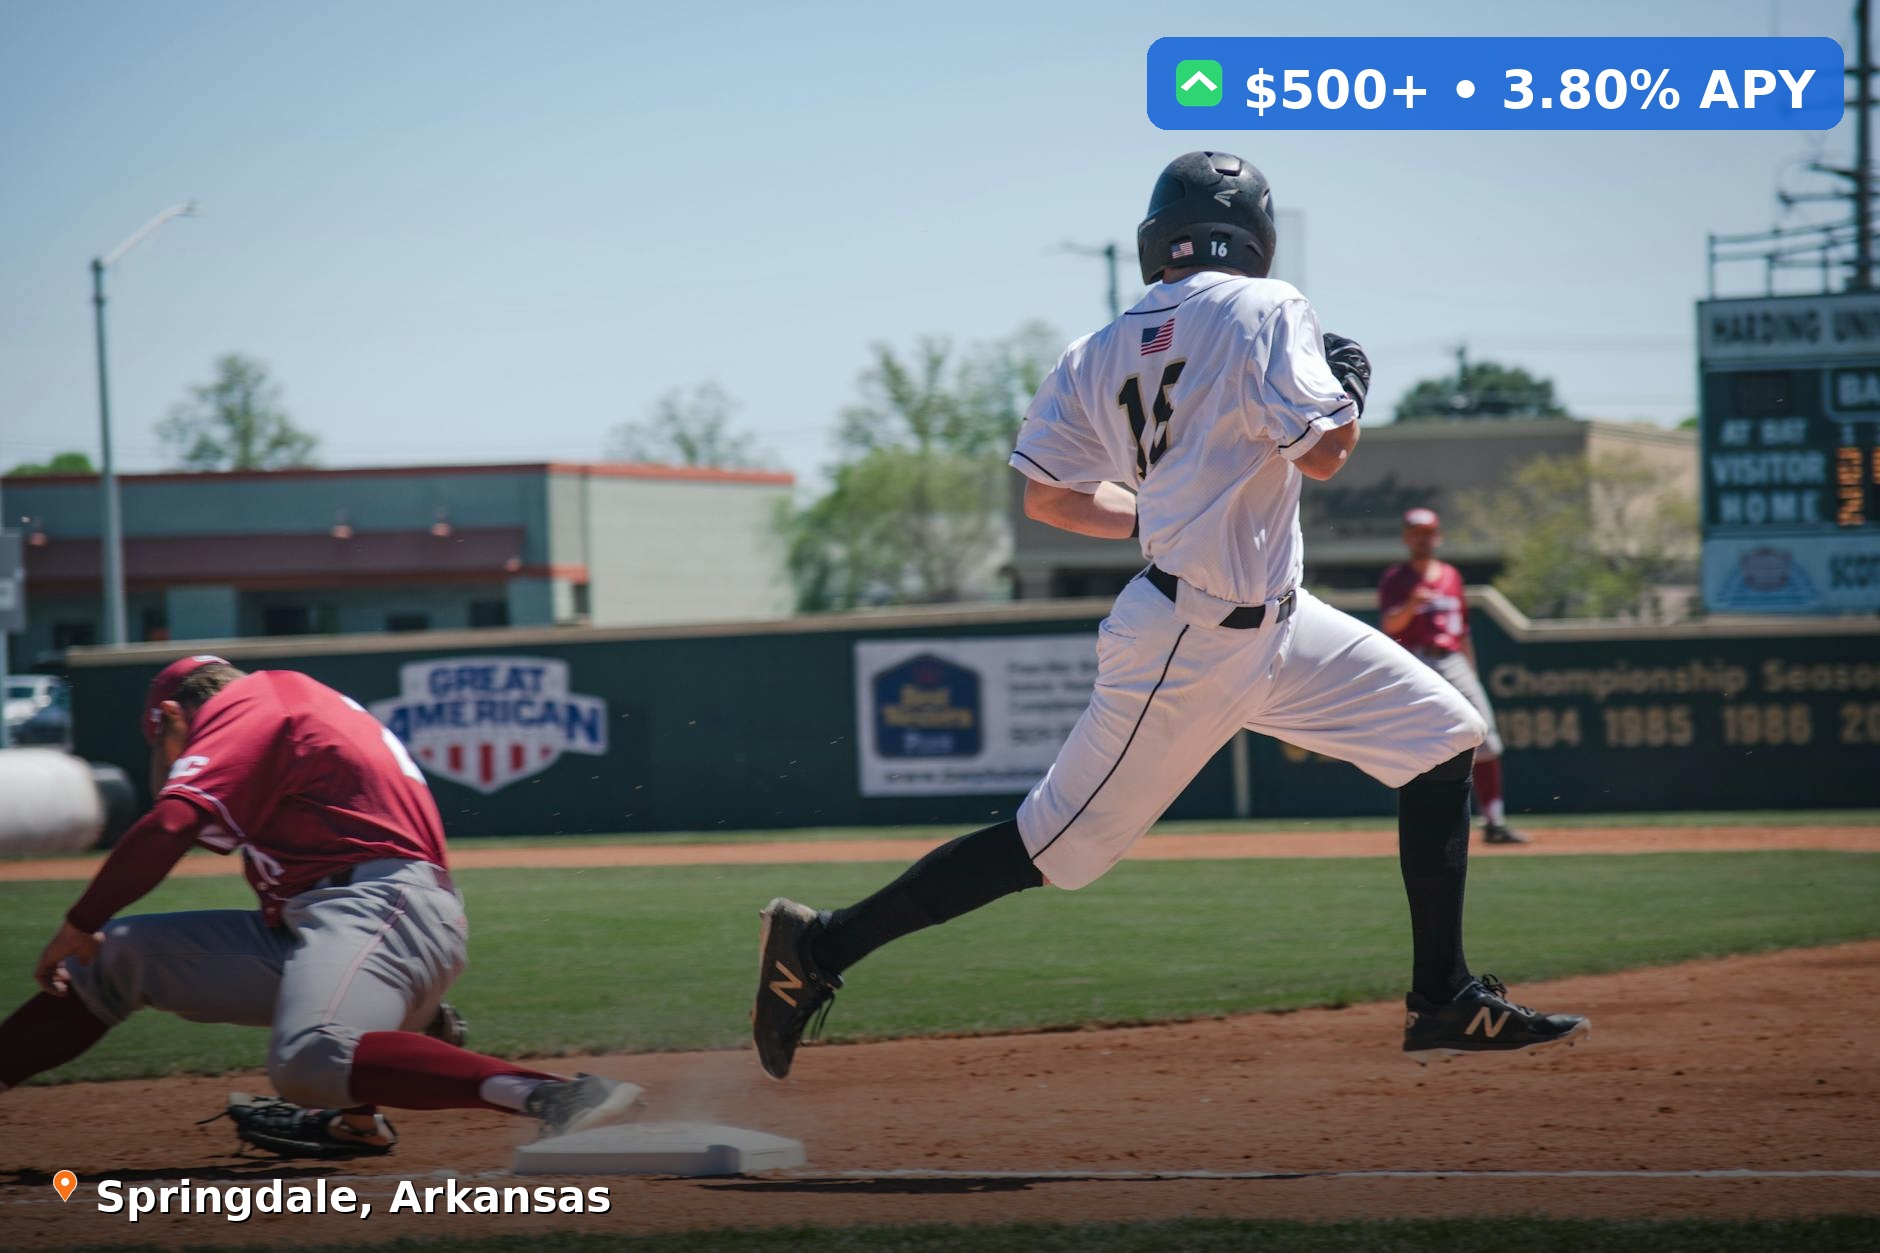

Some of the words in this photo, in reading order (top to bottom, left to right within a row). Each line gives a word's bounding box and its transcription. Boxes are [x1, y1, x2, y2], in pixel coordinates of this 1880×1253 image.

[1211, 241, 1228, 258] 16
[1710, 451, 1826, 485] VISITOR
[1719, 490, 1822, 523] HOME
[428, 665, 546, 697] GREAT
[1490, 658, 1747, 702] Championship
[1761, 657, 1880, 693] Seaso
[387, 698, 600, 744] AMERICAN
[1497, 707, 1580, 748] 1984
[1604, 705, 1695, 748] 1985
[1463, 1006, 1512, 1038] N
